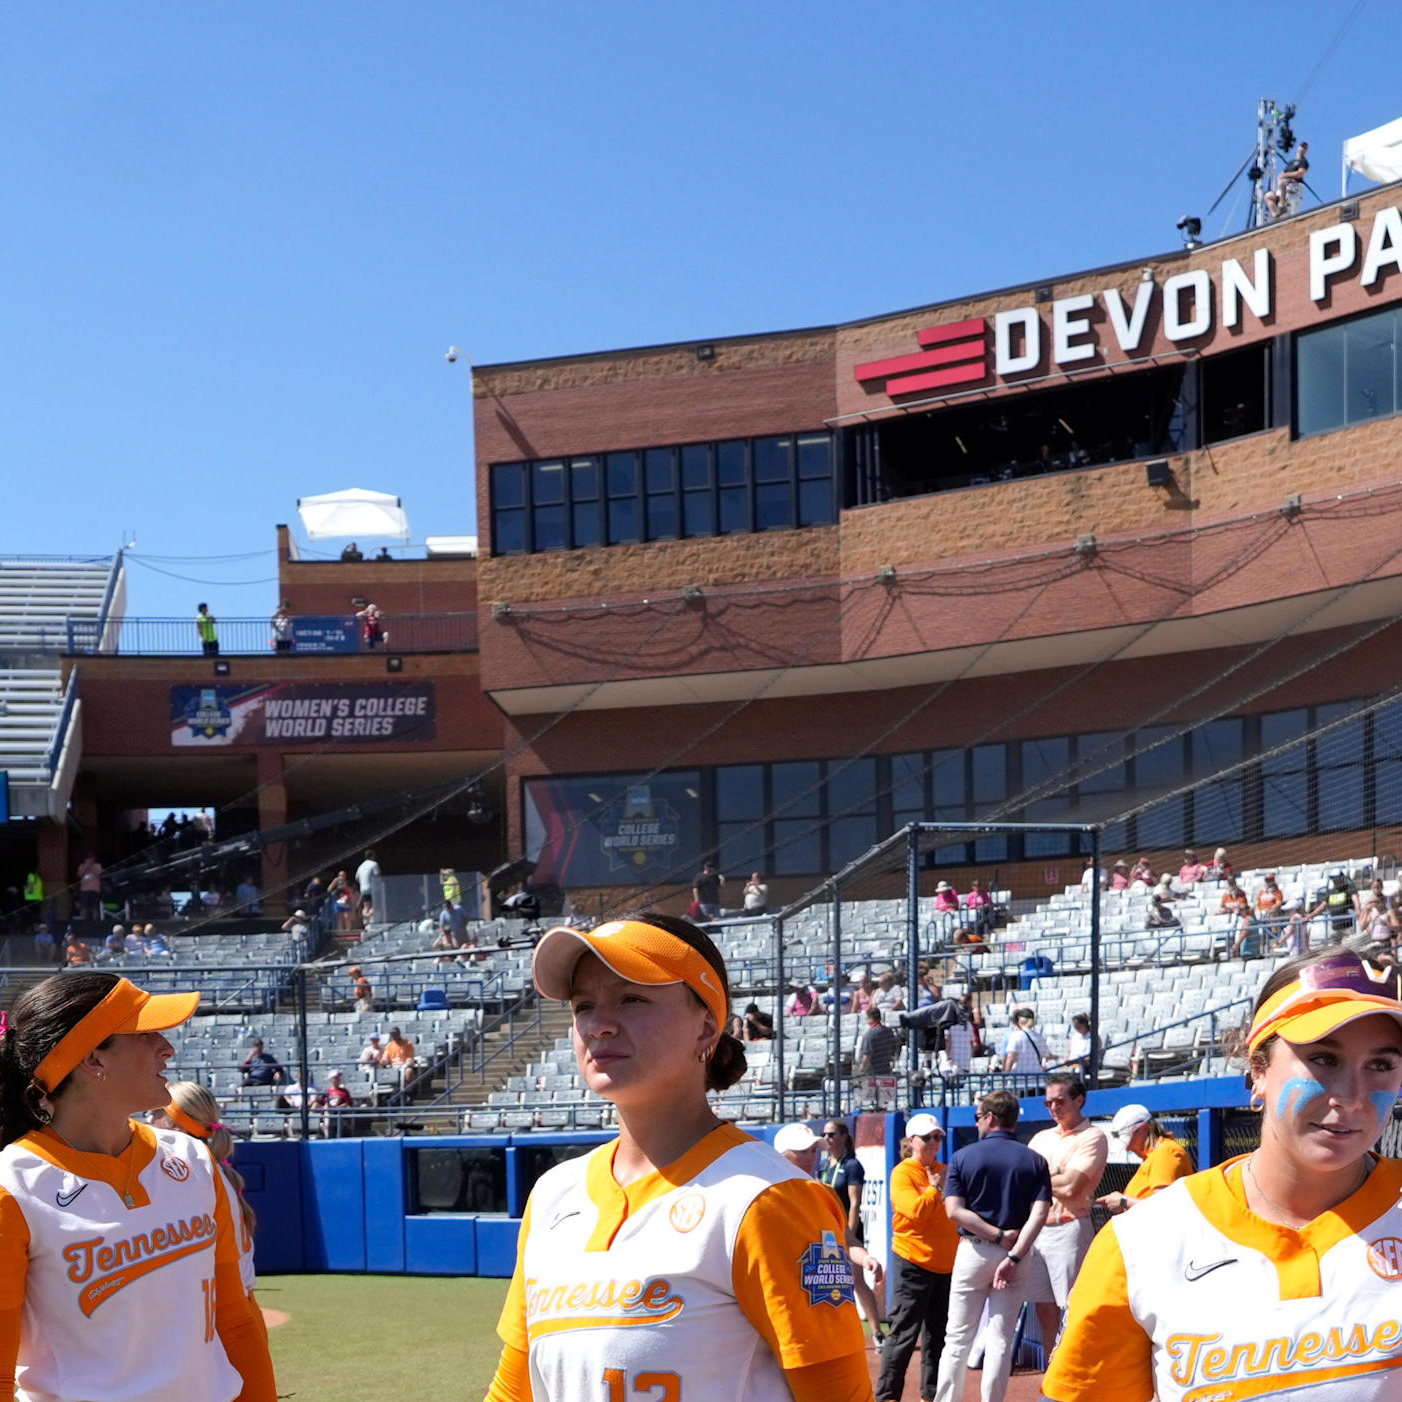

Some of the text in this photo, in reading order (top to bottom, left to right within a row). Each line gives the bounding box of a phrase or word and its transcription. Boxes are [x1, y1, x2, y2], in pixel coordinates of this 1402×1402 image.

[994, 247, 1271, 376] DEVON
[264, 697, 427, 718] WOMEN'S COLLEGE
[265, 717, 394, 737] WORLD SERIES
[618, 823, 660, 835] COLLEGE
[604, 834, 675, 847] WORLD SERIES
[165, 1157, 189, 1180] SEC
[62, 1212, 218, 1284] Tennessee
[817, 1264, 846, 1275] COLLEGE
[804, 1275, 834, 1285] WORLD
